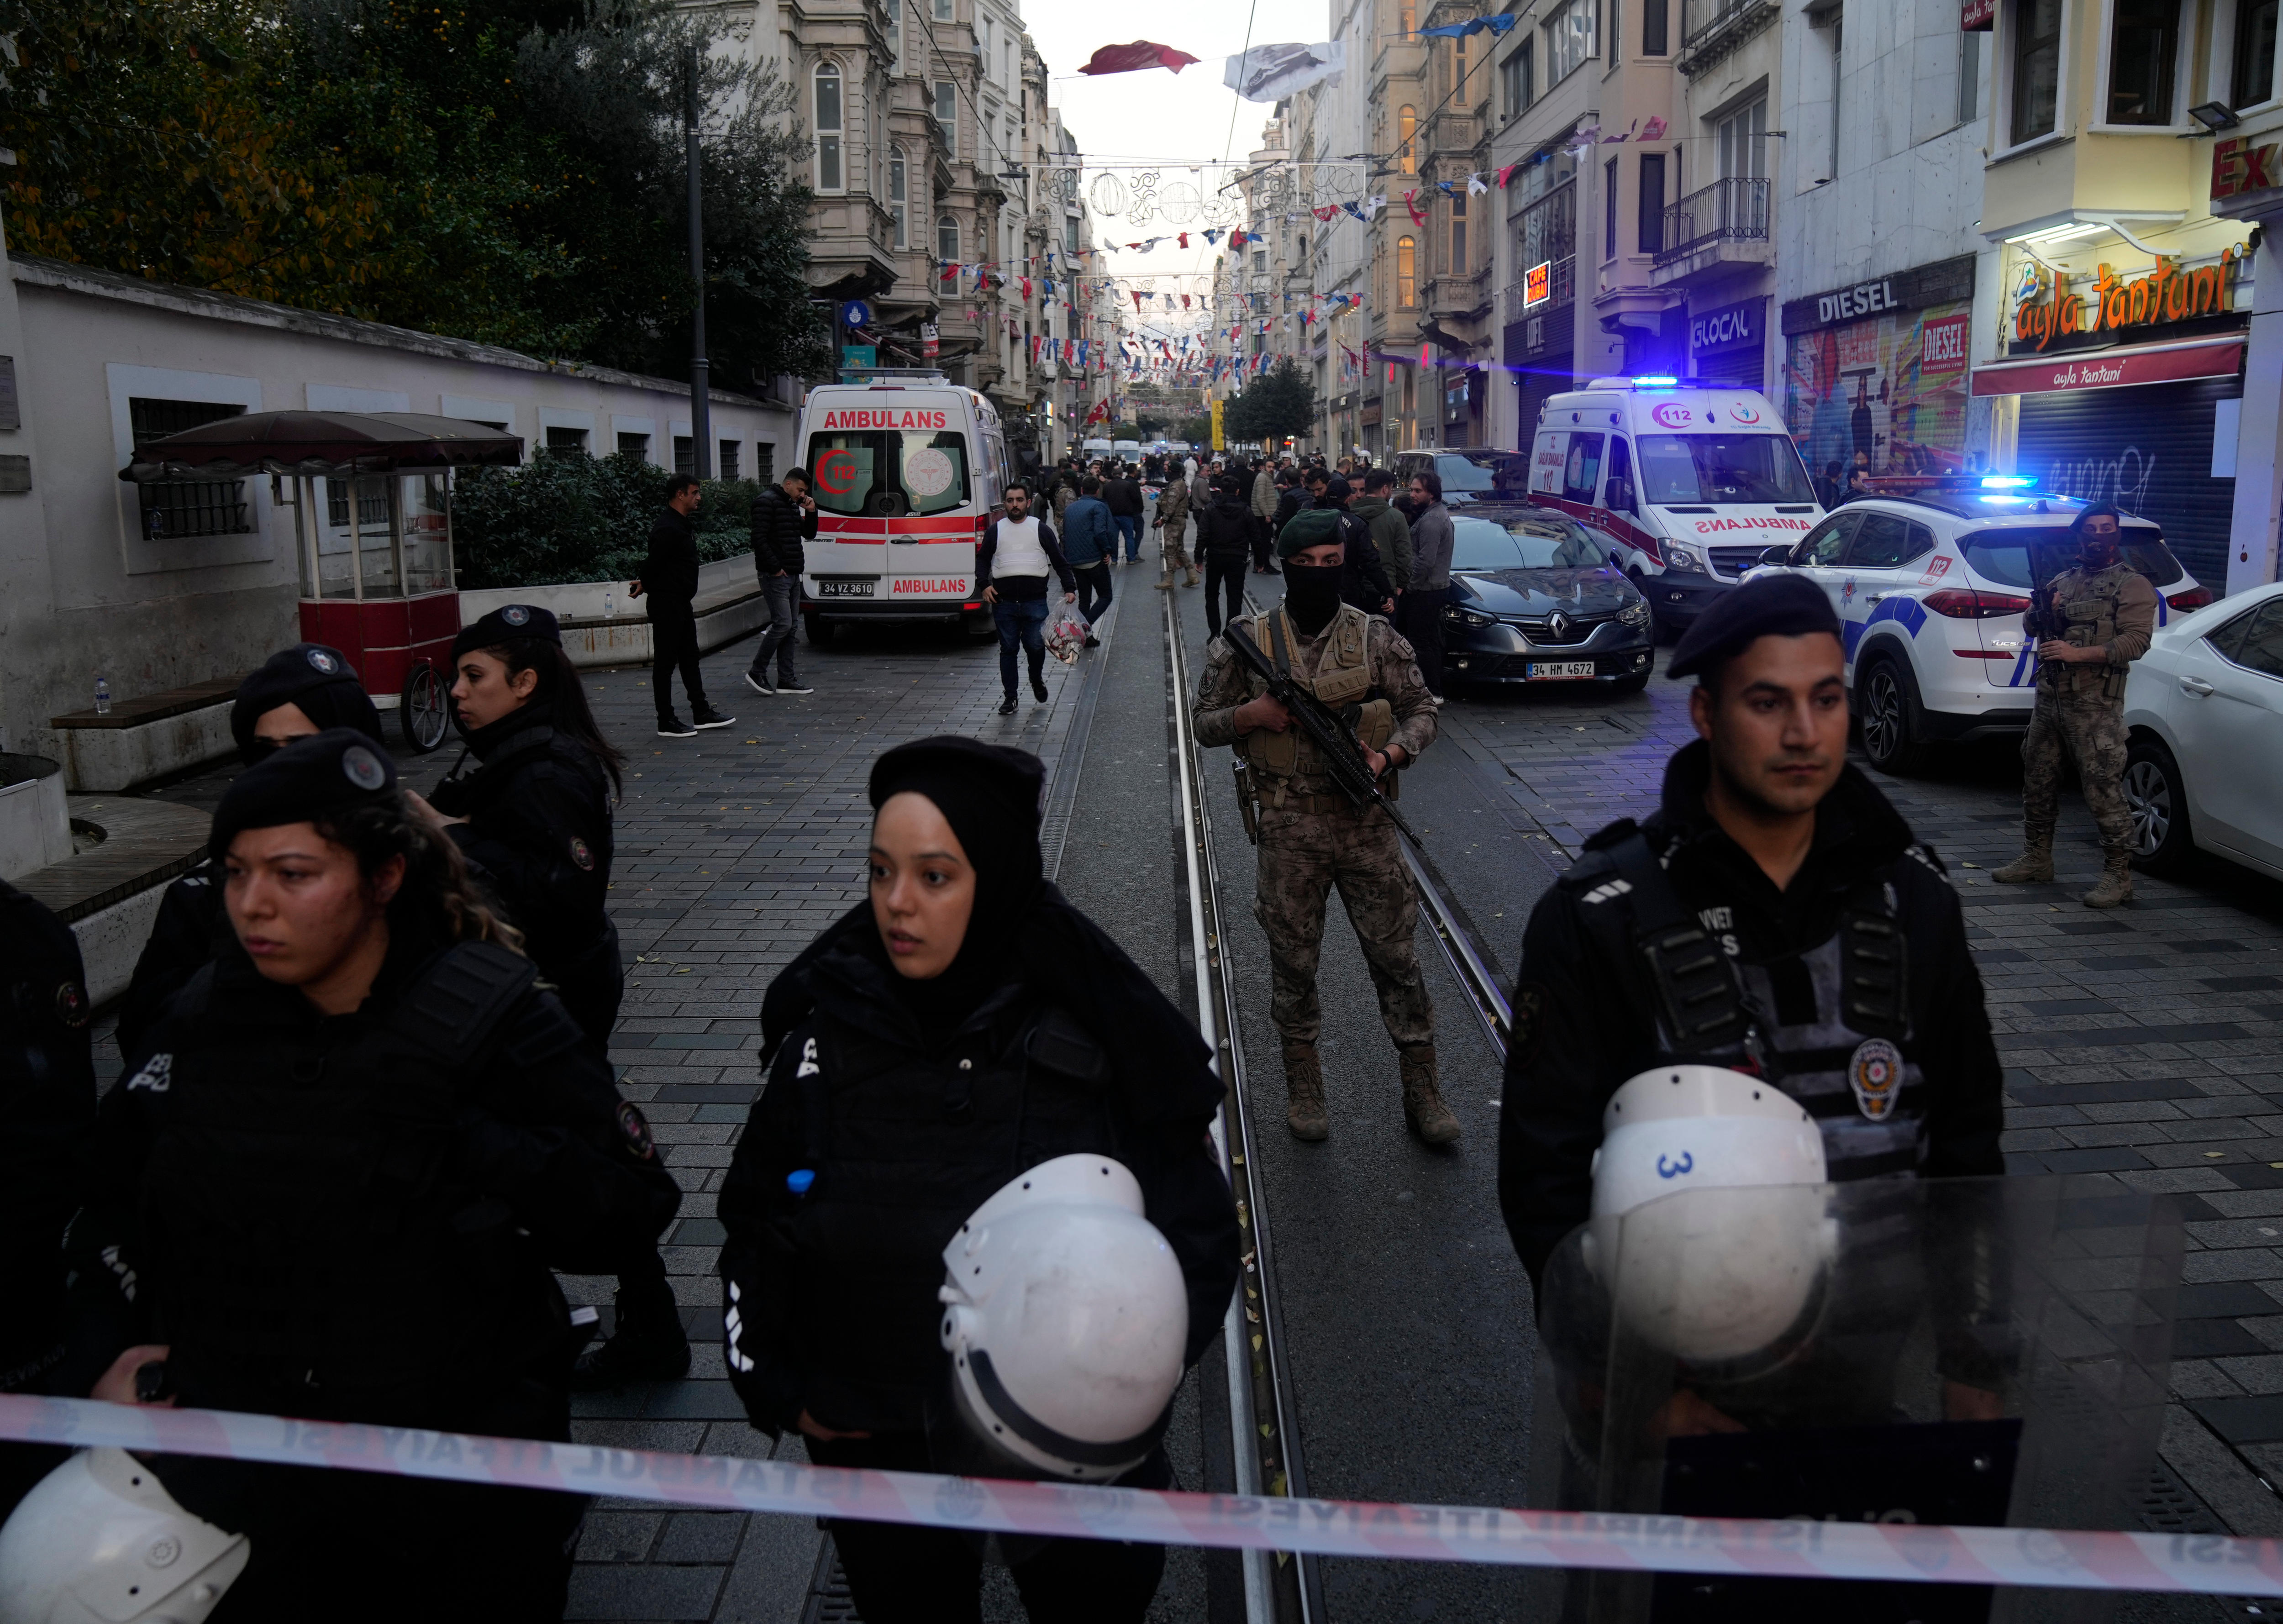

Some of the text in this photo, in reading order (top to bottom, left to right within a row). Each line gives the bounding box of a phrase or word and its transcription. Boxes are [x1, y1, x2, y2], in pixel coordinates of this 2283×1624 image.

[1964, 1, 1981, 24] ayla
[2210, 137, 2282, 200] EX
[1529, 265, 1546, 286] CAFE
[1527, 281, 1547, 304] DUBAI
[1818, 281, 1898, 323] DIESEL
[2016, 248, 2231, 352] ayla tantuni
[1692, 309, 1748, 348] GLOCAL
[1924, 323, 1963, 362] DIESEL
[2053, 365, 2123, 388] ayla tantuni
[824, 411, 946, 428] AMBULANS
[1662, 410, 1692, 420] 112
[832, 465, 855, 479] 112
[1543, 469, 1553, 492] 112
[1341, 516, 1352, 529] VET
[1930, 559, 1947, 575] 112
[825, 584, 872, 593] 34 VZ 3610
[893, 579, 966, 593] AMBULANS
[1533, 663, 1592, 676] 34 HM 4672
